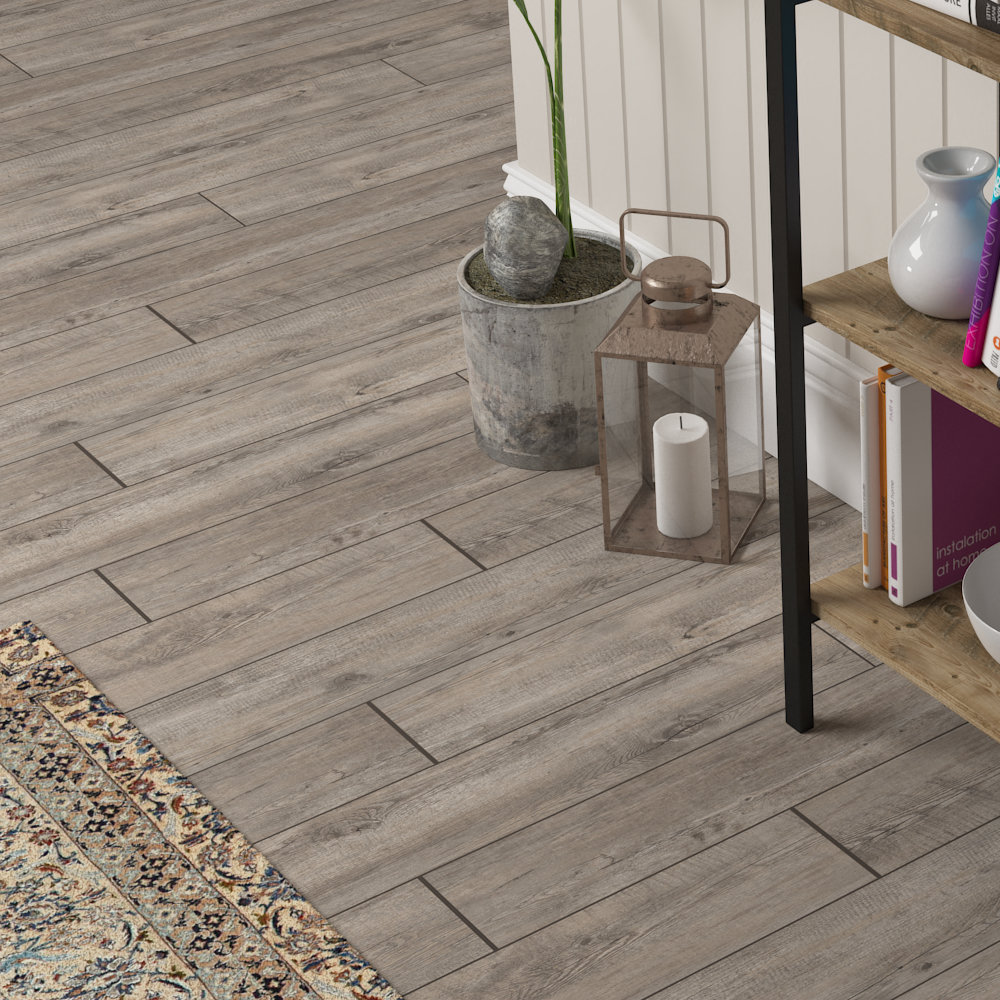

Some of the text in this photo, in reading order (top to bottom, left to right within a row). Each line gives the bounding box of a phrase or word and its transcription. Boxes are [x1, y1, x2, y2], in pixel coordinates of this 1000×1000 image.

[965, 215, 999, 351] EXHIBITION ON
[936, 526, 997, 560] instalation
[936, 548, 986, 577] at hom
